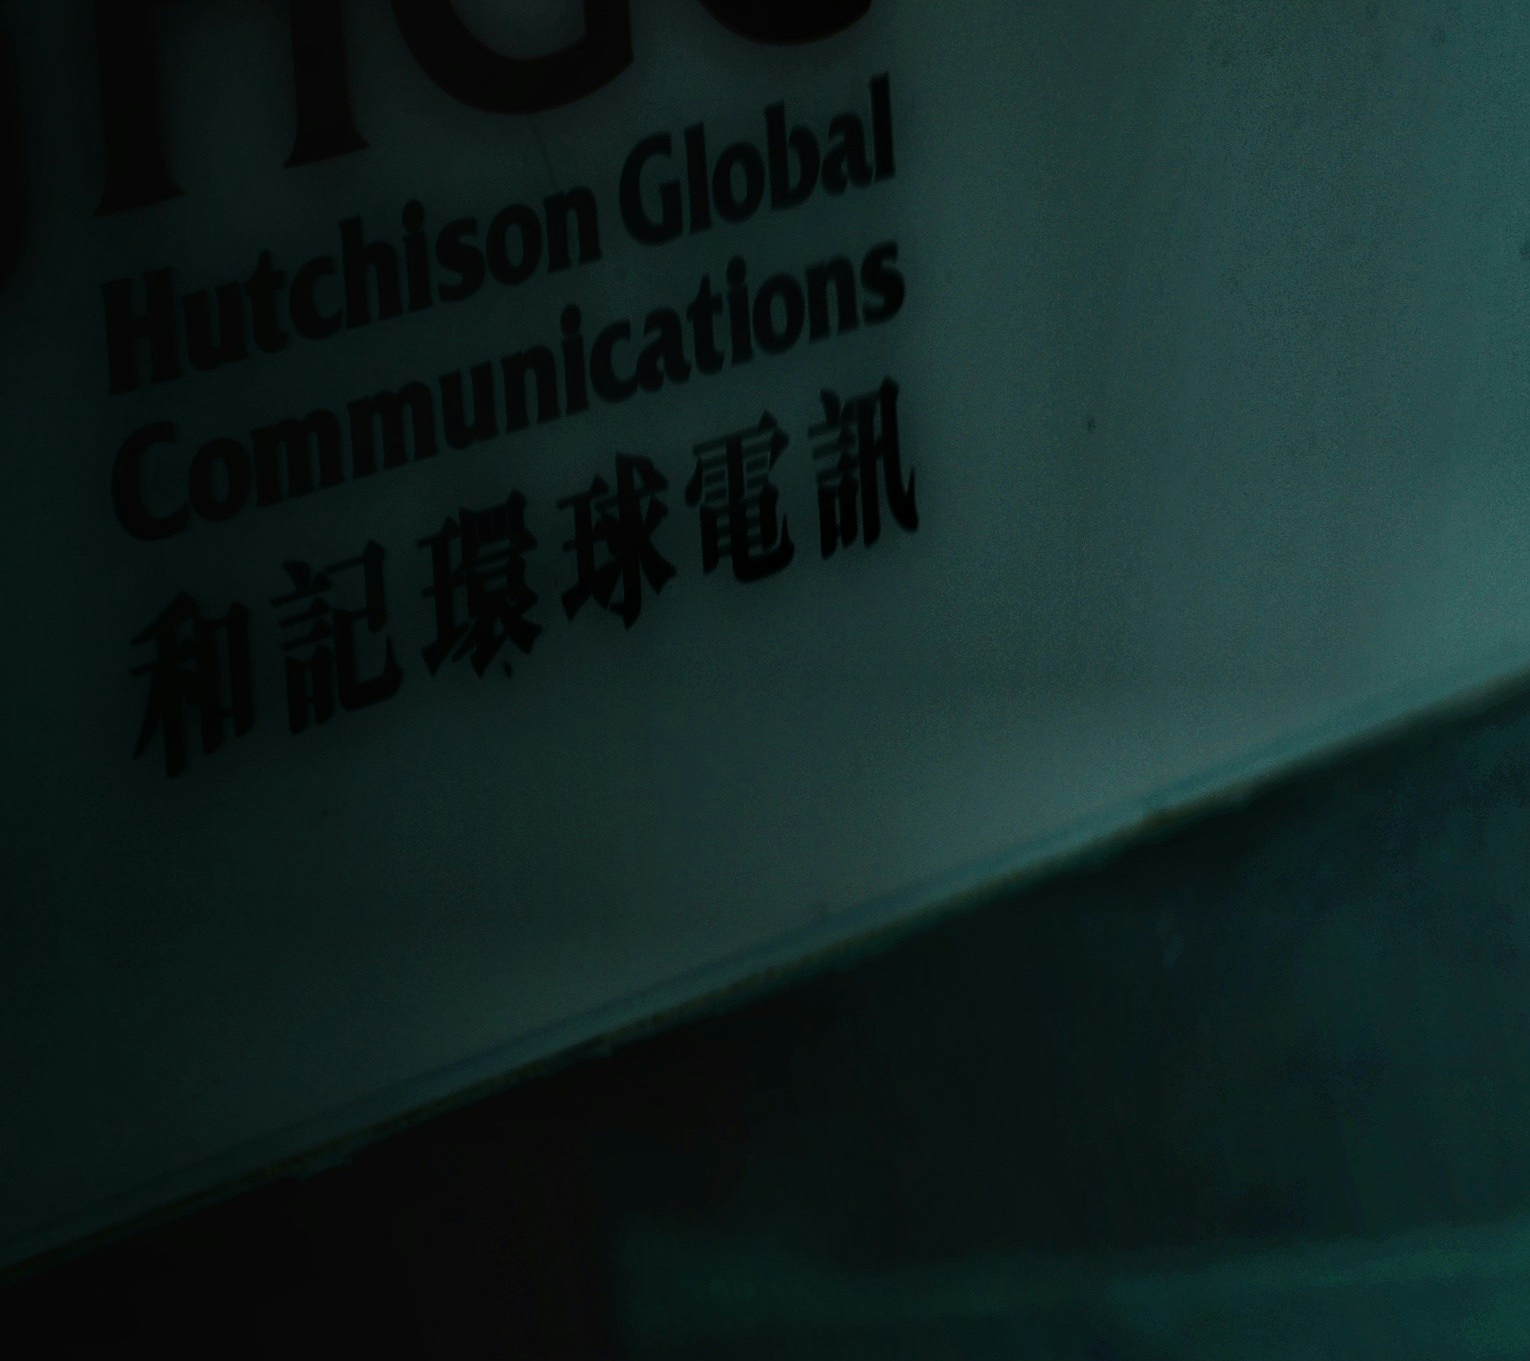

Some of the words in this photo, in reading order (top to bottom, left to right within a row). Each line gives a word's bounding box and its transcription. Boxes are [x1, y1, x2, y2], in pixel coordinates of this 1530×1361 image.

[102, 185, 600, 394] Hutchison
[619, 71, 895, 246] Global
[110, 242, 906, 542] Communications
[130, 378, 919, 779] 和記環球電訊
